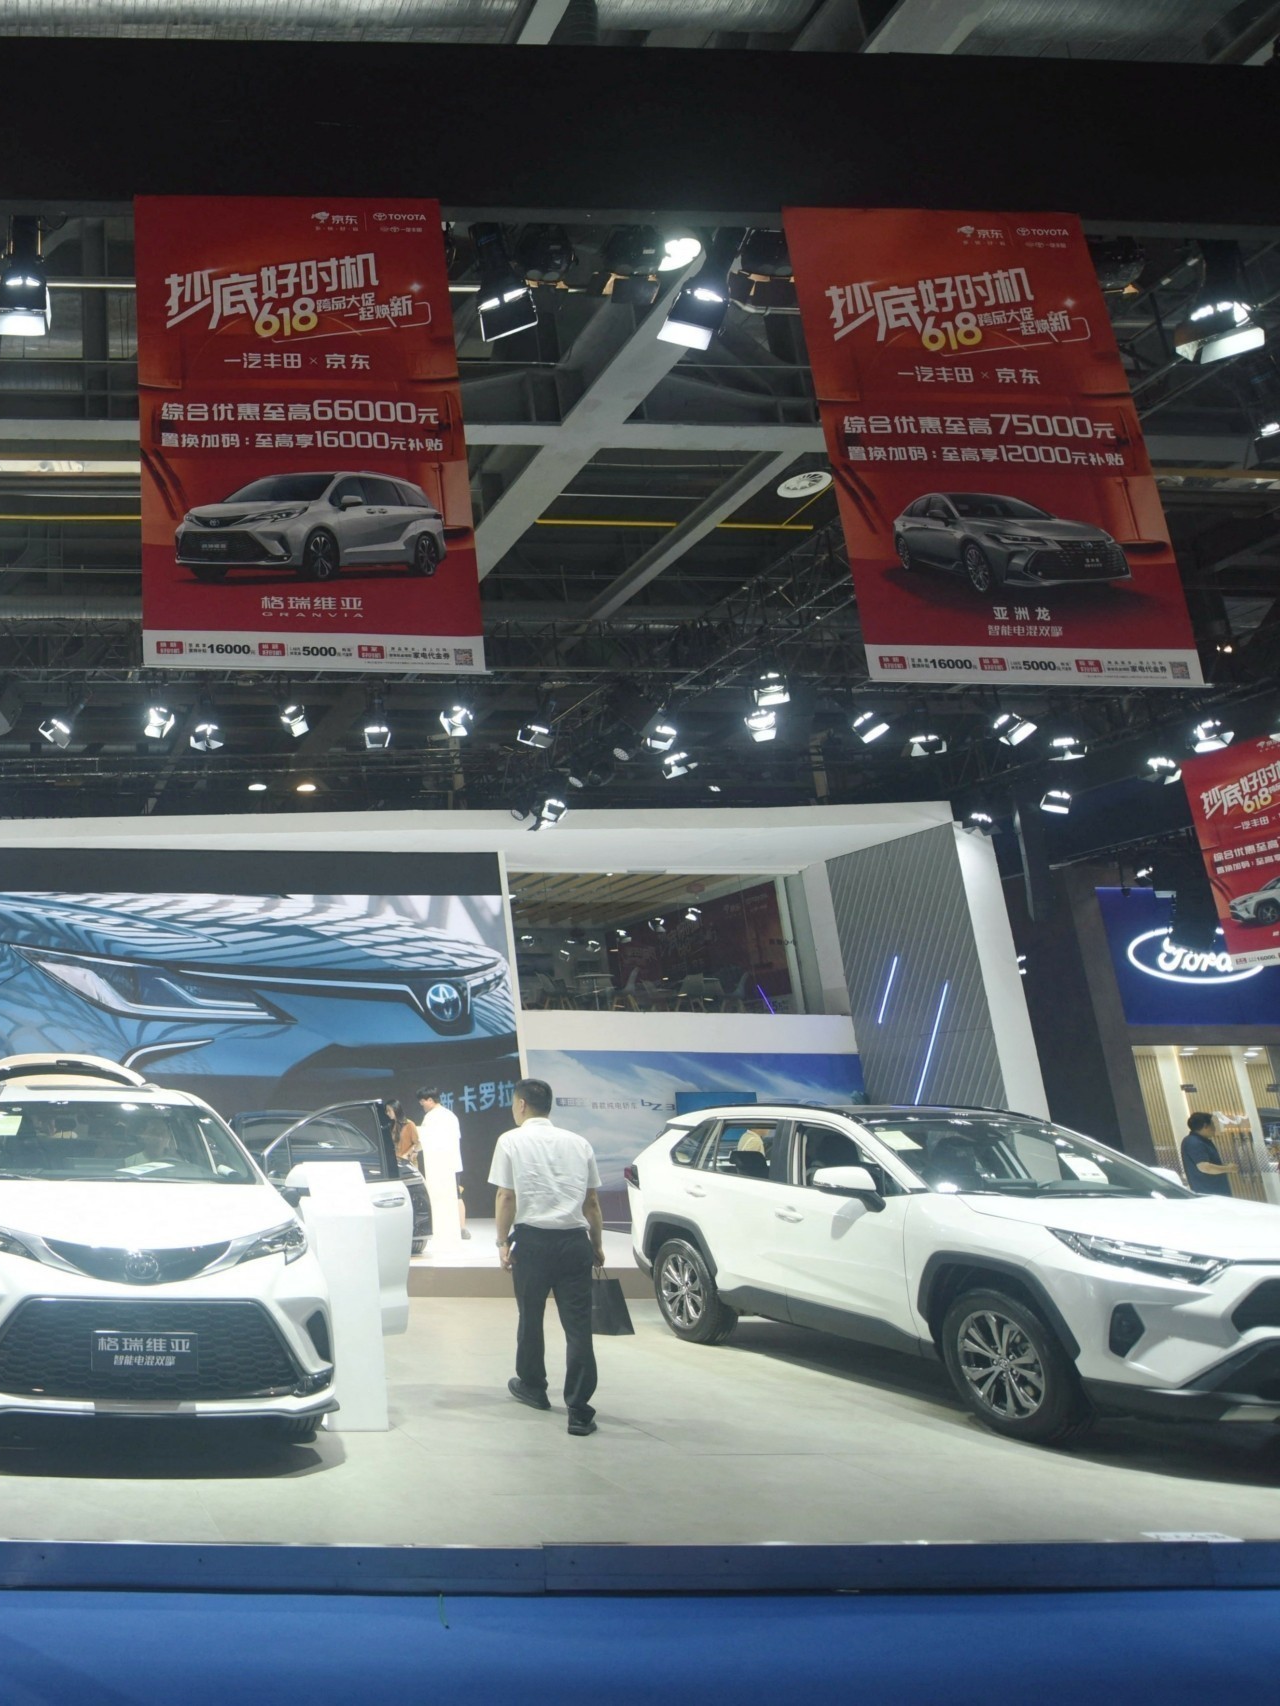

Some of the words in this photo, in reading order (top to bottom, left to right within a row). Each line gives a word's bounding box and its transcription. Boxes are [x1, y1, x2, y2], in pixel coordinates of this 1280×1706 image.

[387, 213, 427, 221] TOYOTA
[1030, 228, 1070, 236] TOYOTA
[164, 252, 380, 330] 抄底好时机
[825, 267, 1035, 342] 抄底好时机
[254, 296, 319, 337] 618
[921, 311, 983, 351] 618
[223, 352, 303, 370] 一汽丰田
[325, 352, 371, 371] 京东
[897, 366, 974, 384] 一汽丰田
[995, 367, 1041, 386] 京东
[261, 595, 364, 611] 格瑞维亚
[992, 605, 1052, 622] 亚洲龙
[1200, 760, 1280, 820] 抄底好时
[1243, 786, 1272, 814] 618
[1213, 836, 1280, 863] 综合优惠至高
[97, 1336, 191, 1353] 格瑞维亚
[113, 1355, 176, 1367] 智能电混双擎
